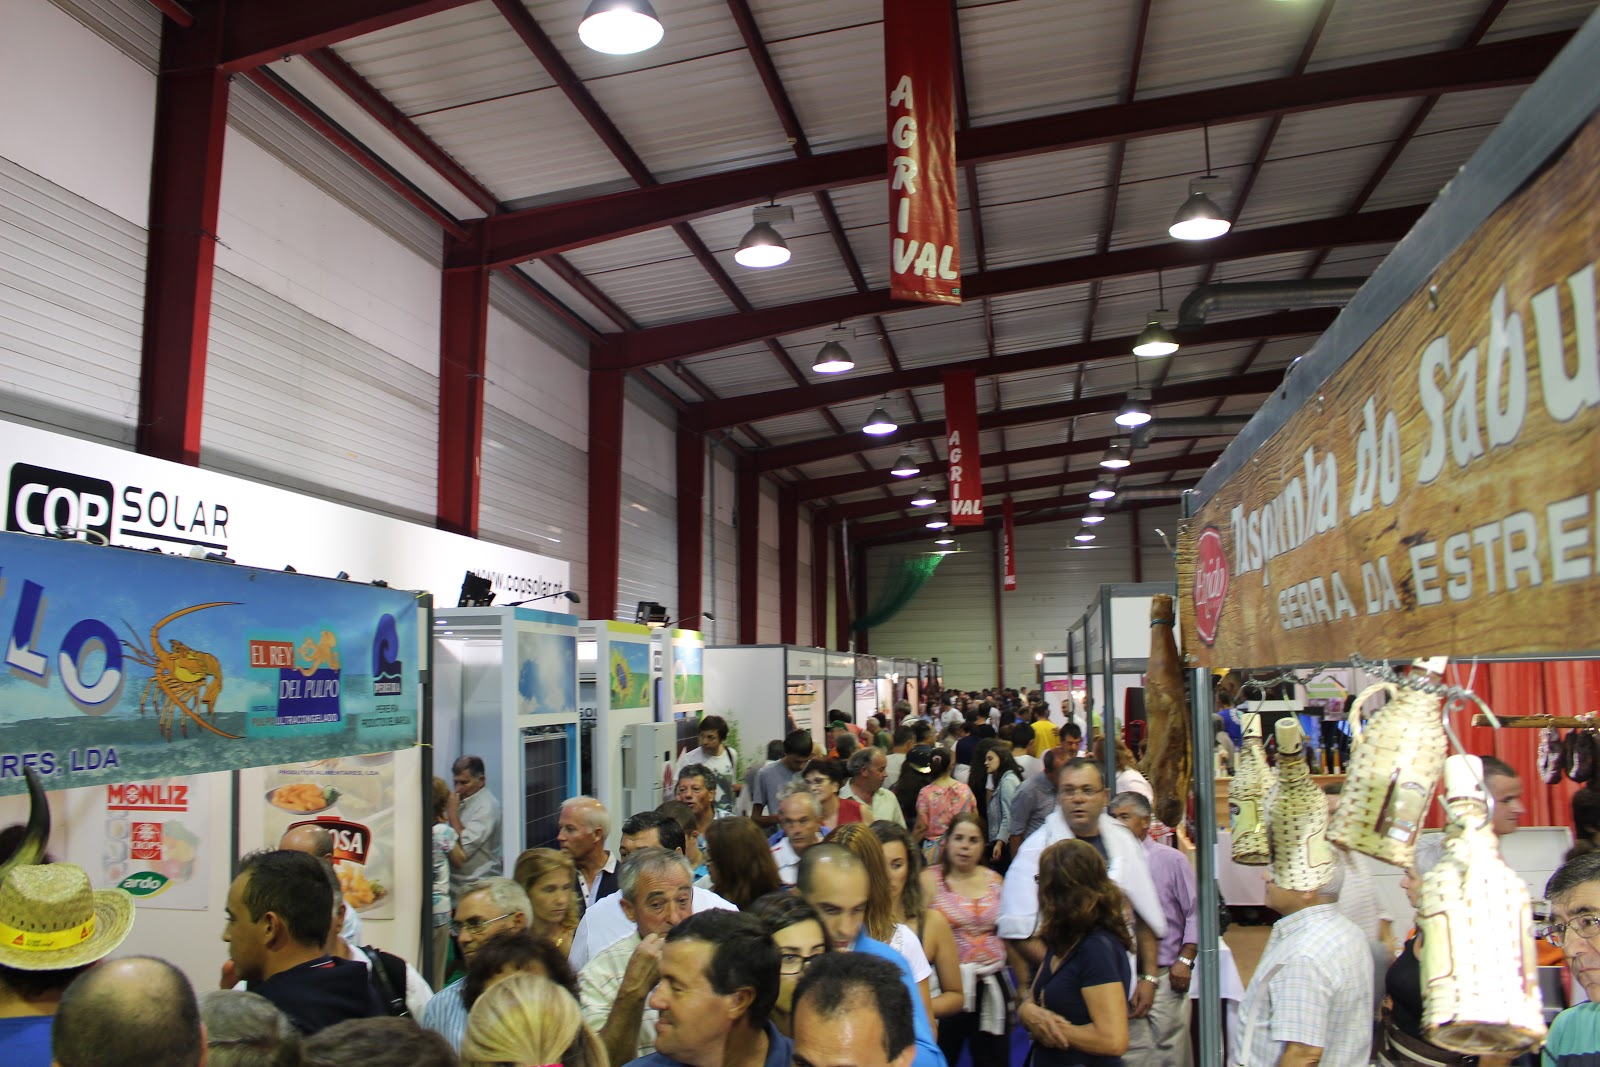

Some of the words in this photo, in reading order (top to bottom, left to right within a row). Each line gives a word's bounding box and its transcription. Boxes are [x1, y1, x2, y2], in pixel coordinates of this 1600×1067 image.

[1350, 396, 1401, 518] do
[15, 482, 109, 541] COP
[121, 485, 229, 539] SOLAR
[1278, 571, 1357, 631] SERRA
[1361, 555, 1401, 615] DA
[1409, 488, 1600, 607] ESTRE
[474, 568, 563, 604] ww.copsolar.pt
[0, 566, 123, 706] LO
[251, 645, 267, 665] EL
[269, 646, 293, 666] REY
[279, 680, 302, 699] DEL
[304, 680, 339, 698] PULPO
[71, 748, 119, 772] LDA
[107, 784, 188, 805] MONLIZ
[132, 841, 162, 850] CROPS
[123, 877, 161, 889] ardo
